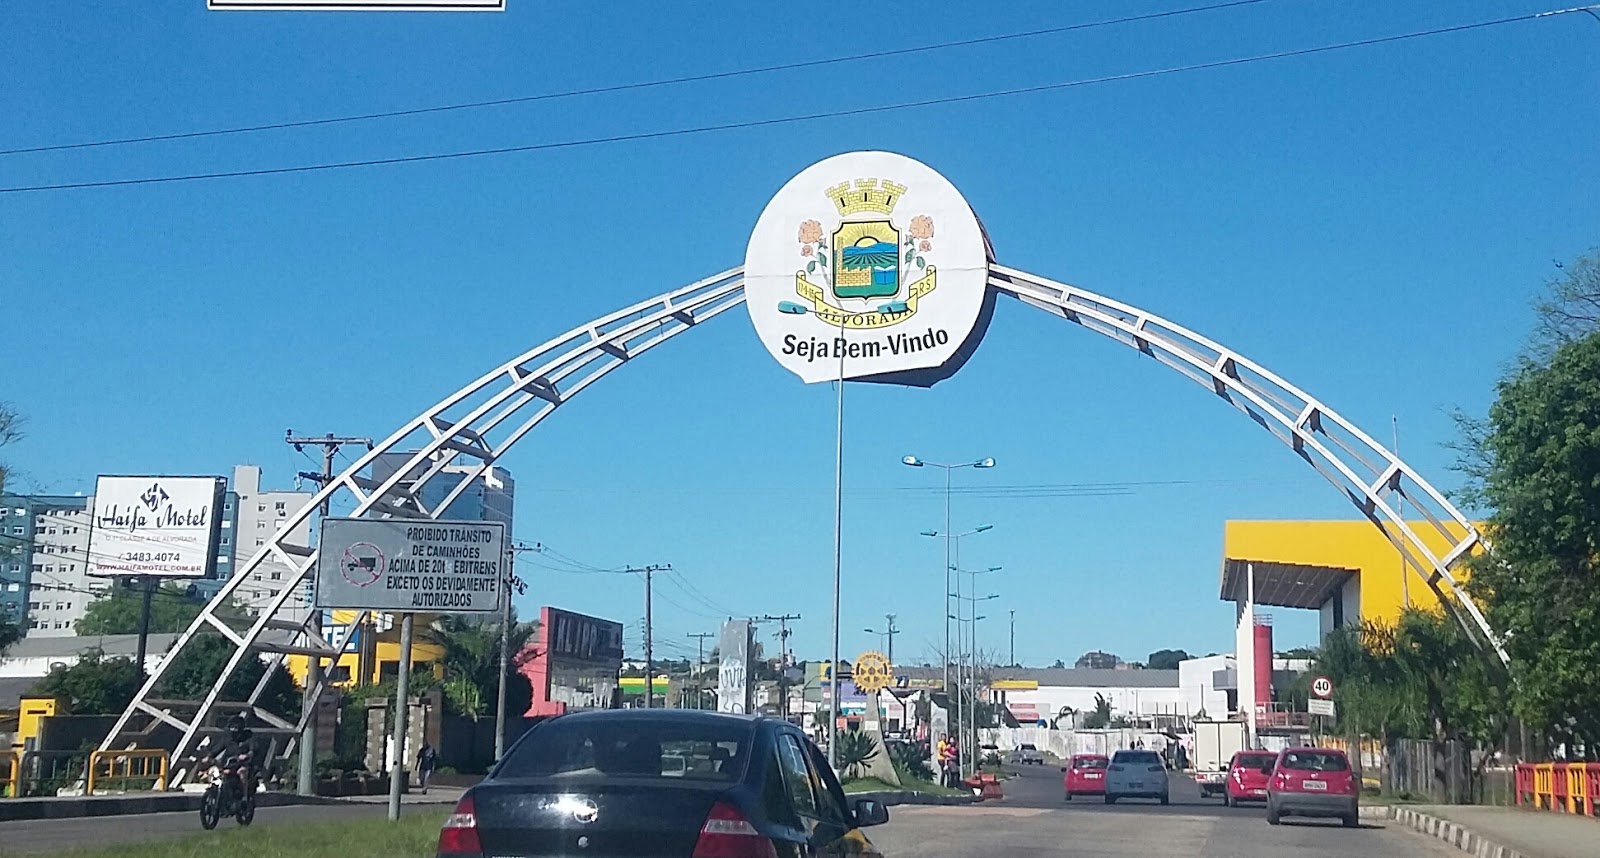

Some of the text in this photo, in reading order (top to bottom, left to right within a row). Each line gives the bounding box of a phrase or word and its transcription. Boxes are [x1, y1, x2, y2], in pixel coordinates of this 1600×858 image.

[818, 308, 914, 326] ALVORADA
[782, 327, 949, 363] Seja Bem-Vindo
[97, 503, 208, 533] Haifa Motel
[407, 527, 448, 542] PROIBIDO
[125, 552, 180, 562] 3483.4074
[412, 544, 480, 558] DE CAMINHÕES
[388, 558, 416, 573] ACIMA
[418, 559, 430, 573] DE
[386, 576, 496, 592] EXCETO OS DEVIDAMENTE
[411, 592, 472, 607] AUTORIZADOS
[1315, 681, 1329, 691] 40
